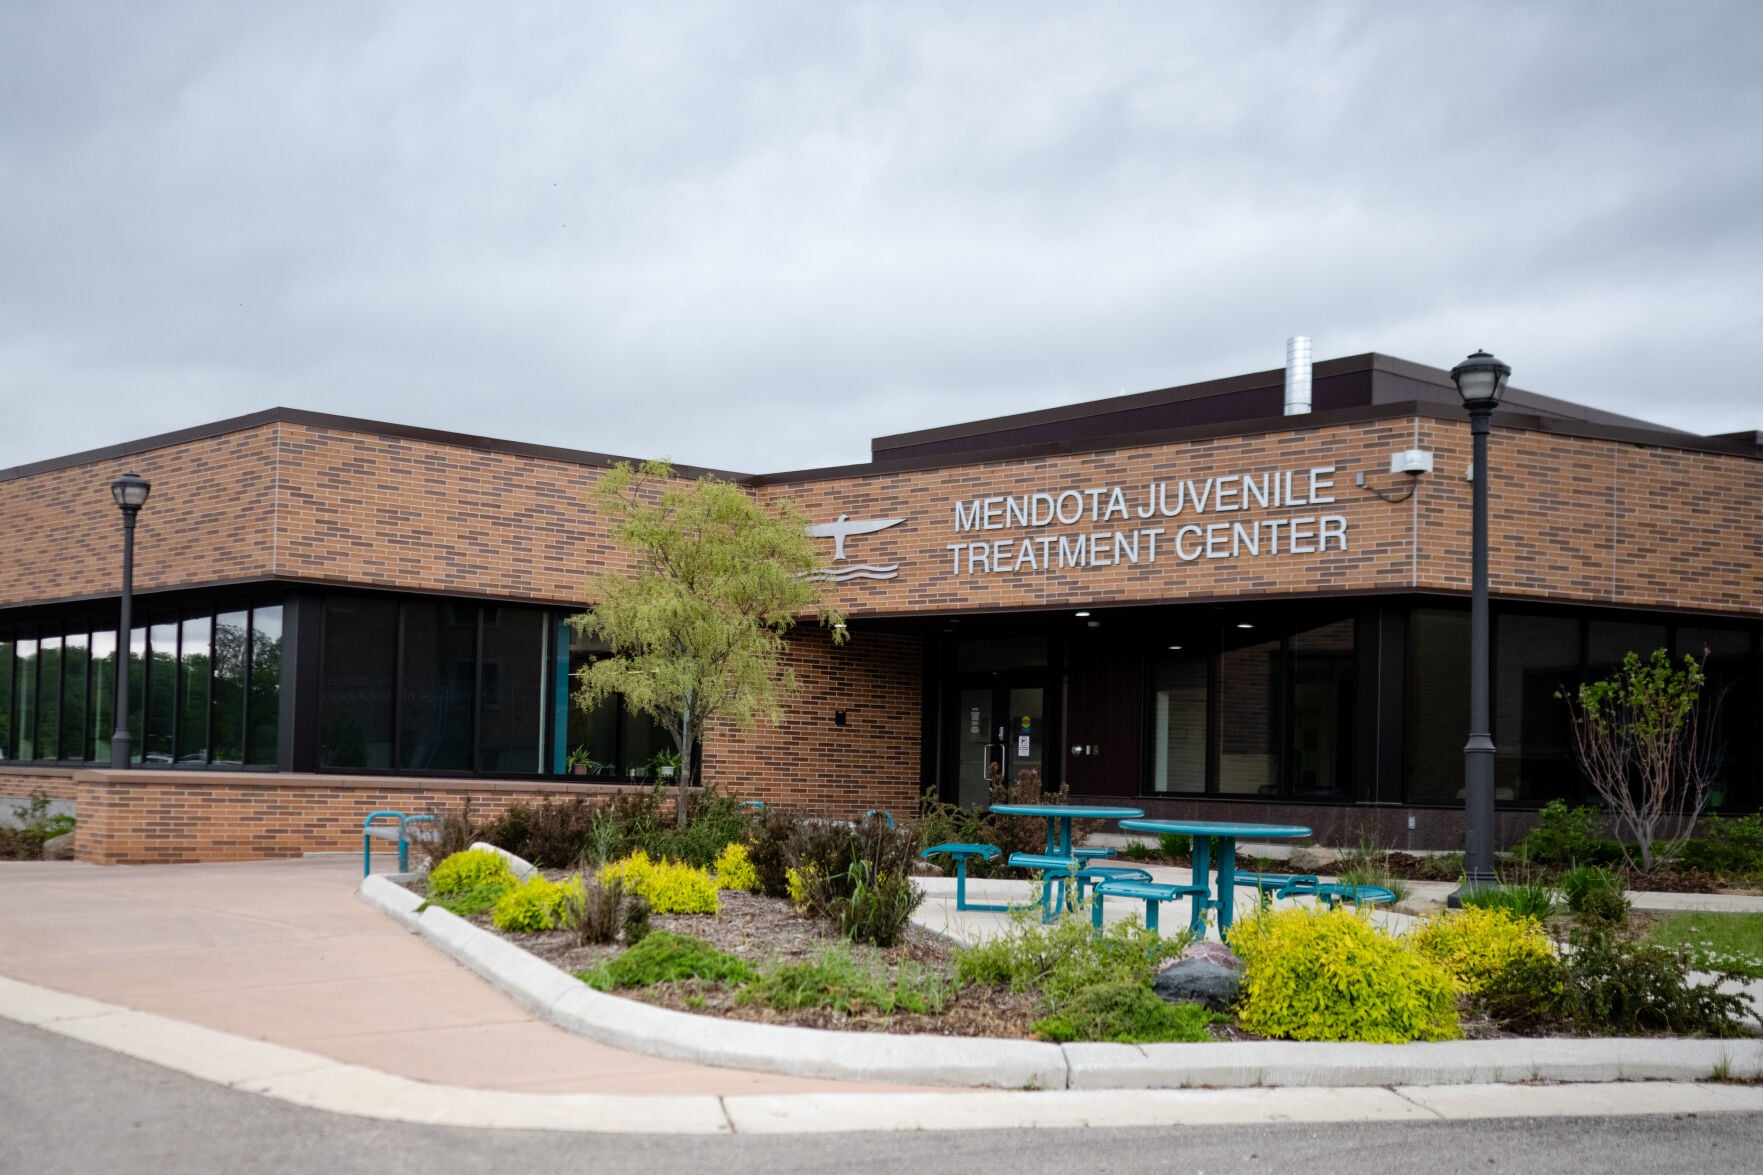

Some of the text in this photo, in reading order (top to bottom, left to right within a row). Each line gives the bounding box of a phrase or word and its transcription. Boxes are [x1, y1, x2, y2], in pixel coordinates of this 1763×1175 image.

[955, 466, 1336, 532] MENDOTA JUVENILE
[946, 515, 1348, 575] TREATMENT CENTER
